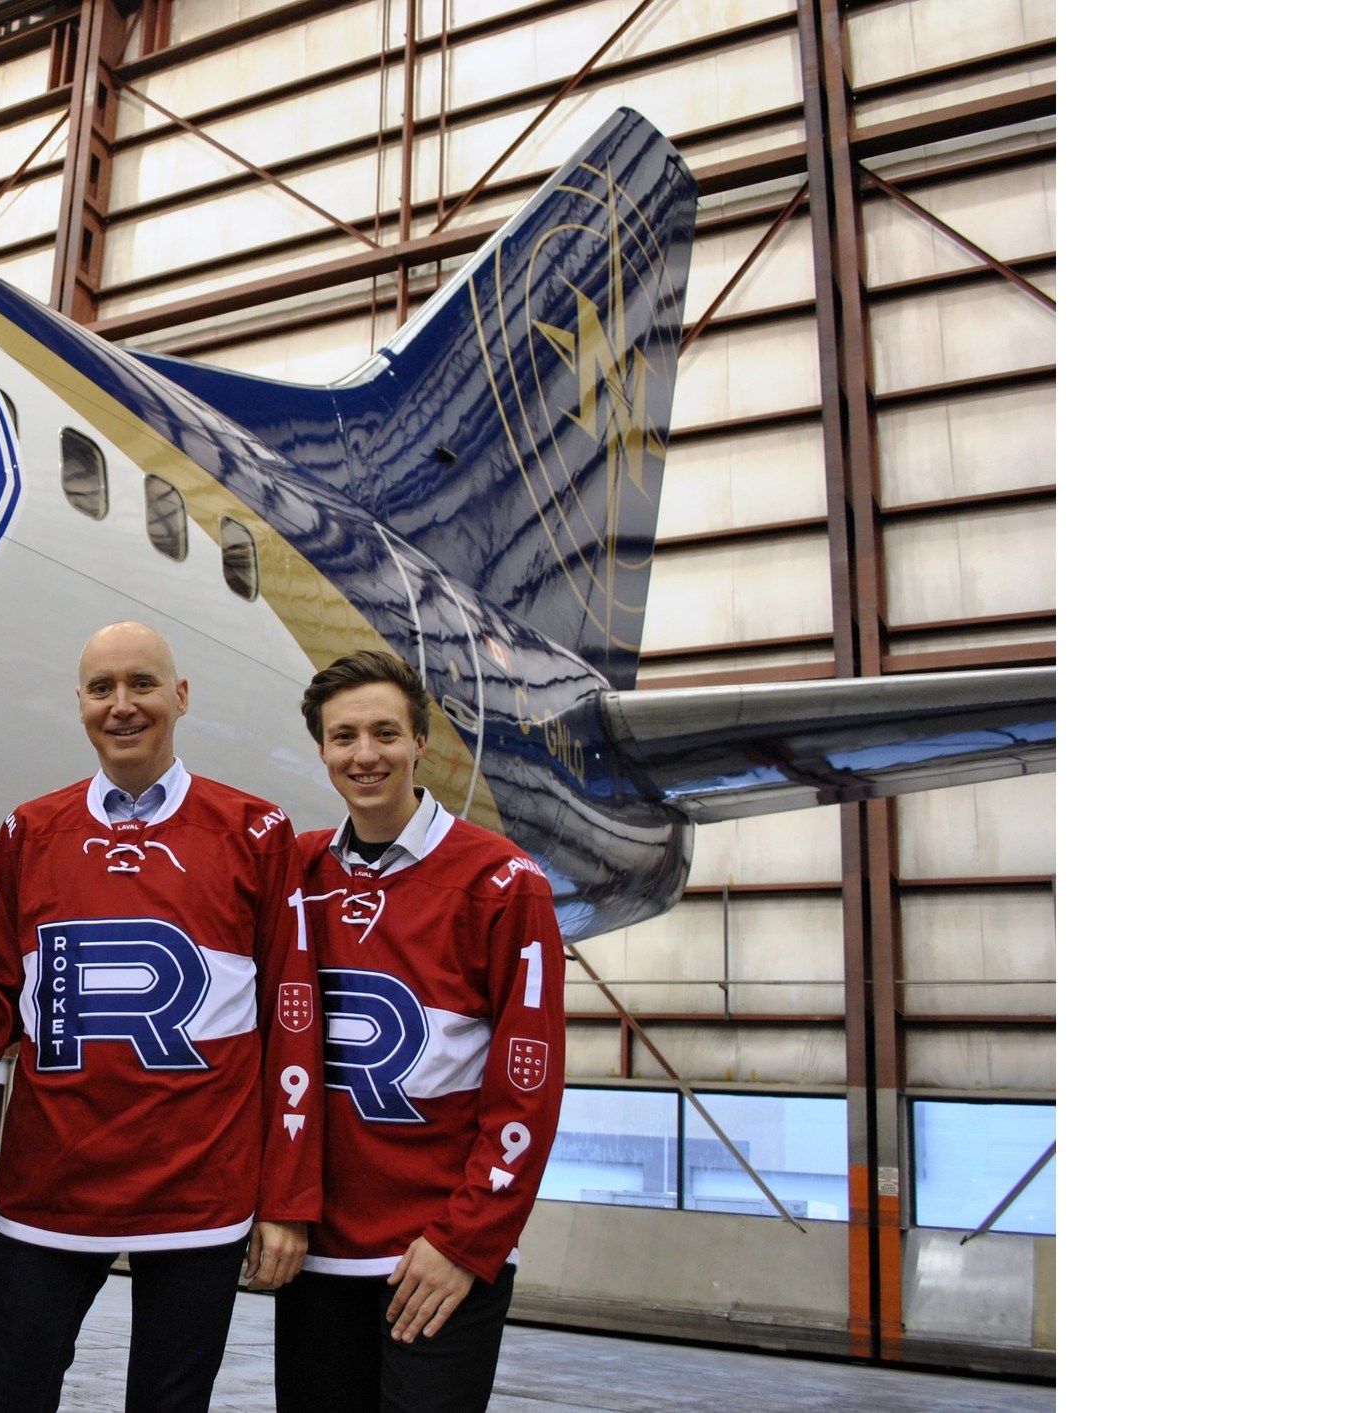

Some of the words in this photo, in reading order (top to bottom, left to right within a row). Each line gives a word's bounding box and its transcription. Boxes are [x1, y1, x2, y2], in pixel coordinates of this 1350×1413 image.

[4, 811, 17, 839] VAL
[248, 808, 287, 839] LAV
[354, 870, 373, 879] LAVAL
[288, 888, 307, 951] 1
[520, 941, 543, 1008] 1
[52, 936, 67, 1056] ROCKET
[283, 999, 308, 1007] ROC
[283, 1010, 308, 1018] KET
[514, 1055, 541, 1066] ROC
[515, 1044, 533, 1053] LE
[513, 1067, 540, 1077] KET
[280, 1065, 310, 1108] 9
[500, 1121, 531, 1166] 9
